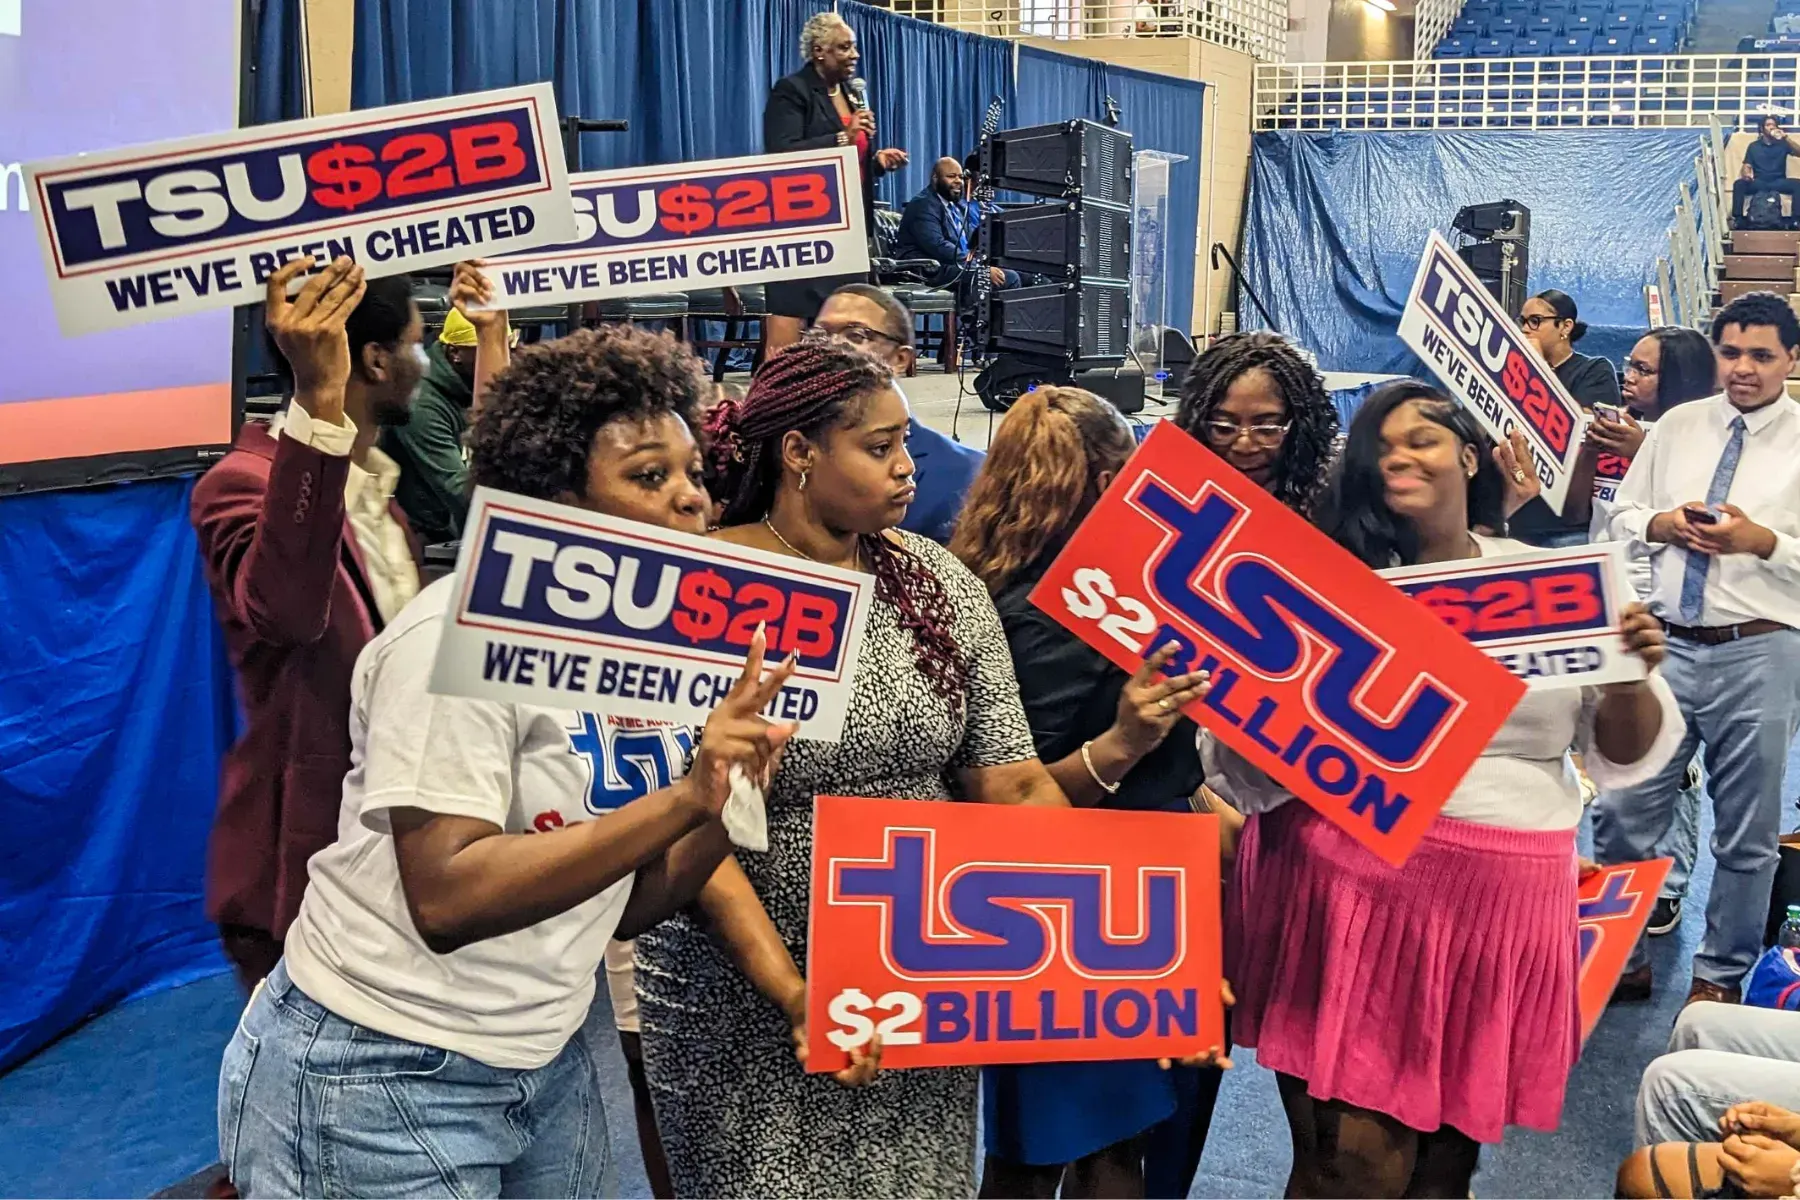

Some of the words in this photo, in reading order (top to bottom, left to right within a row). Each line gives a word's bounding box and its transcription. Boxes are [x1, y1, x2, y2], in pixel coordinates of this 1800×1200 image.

[62, 121, 527, 250] TSU$2B
[561, 173, 832, 244] SU$2B
[106, 259, 242, 312] WE'VE
[366, 204, 535, 262] CHEATED
[502, 263, 600, 296] WE'VE
[608, 254, 688, 285] BEEN
[696, 240, 834, 276] CHEATED
[1421, 324, 1466, 390] WE'VE
[1466, 375, 1504, 429] BEEN
[1434, 260, 1570, 453] TSU$2B
[492, 530, 839, 658] TSU$2B
[1123, 469, 1468, 773] tsu
[483, 641, 590, 692] WE'VE
[595, 659, 682, 704] BEEN
[688, 672, 819, 722] CHTED
[828, 826, 1187, 982] tsu
